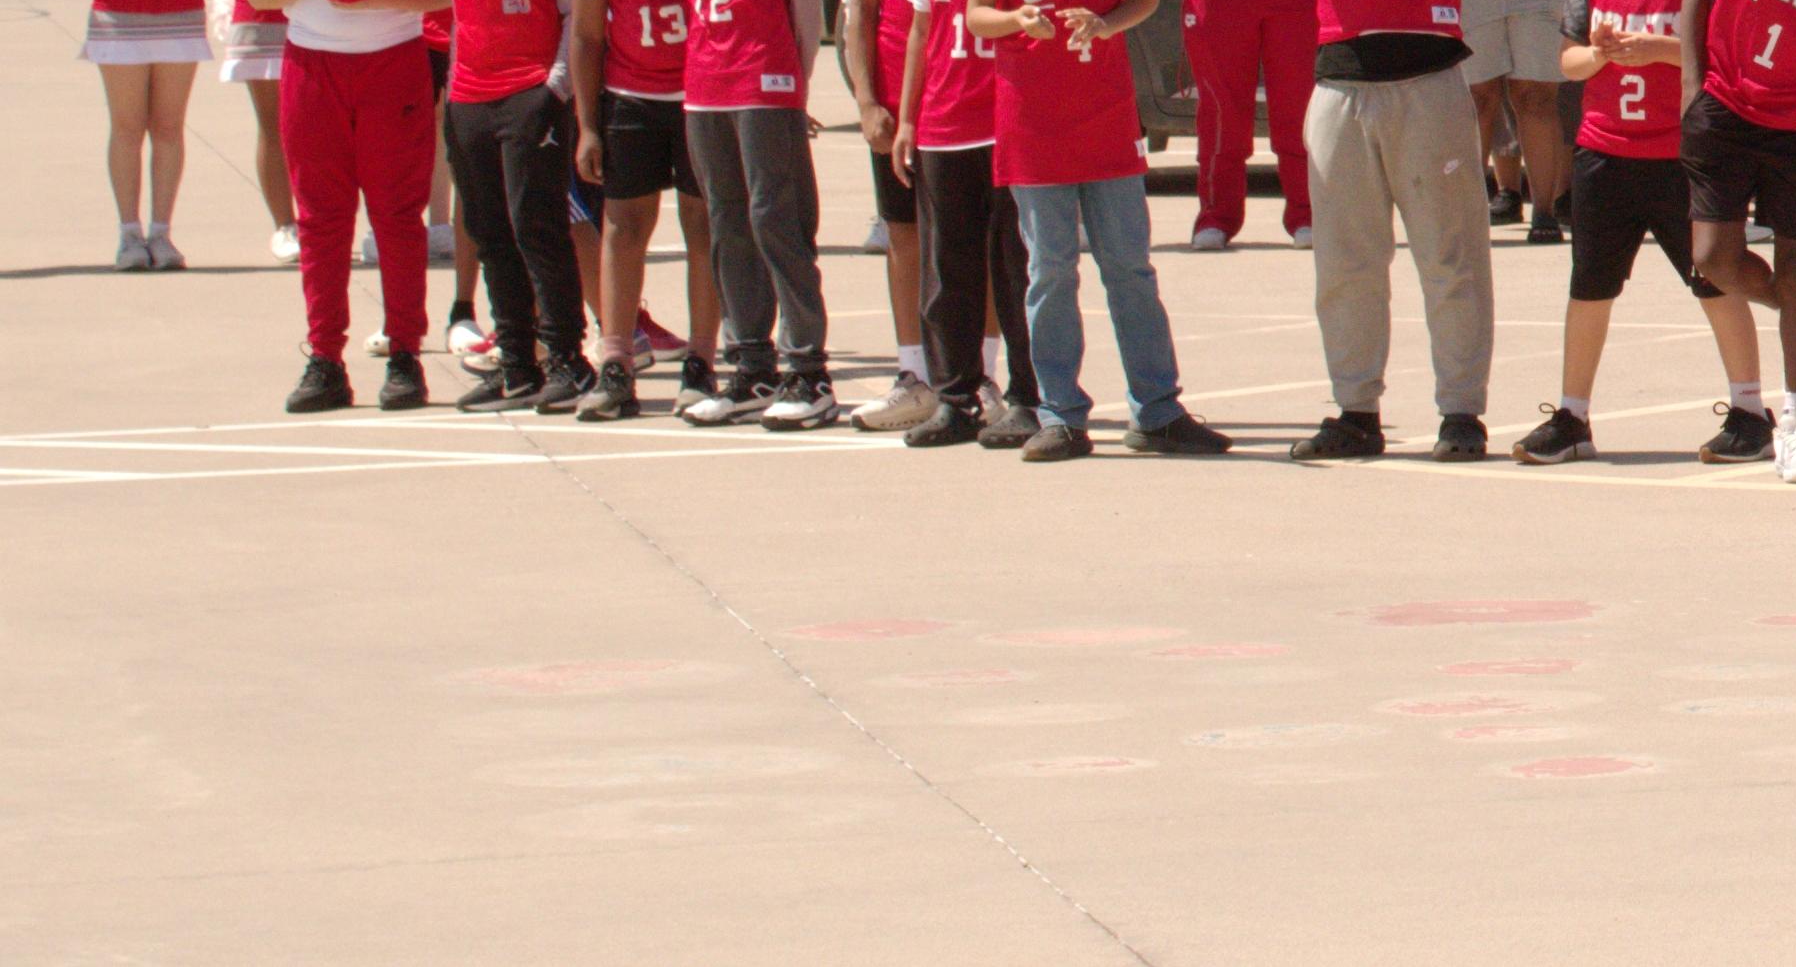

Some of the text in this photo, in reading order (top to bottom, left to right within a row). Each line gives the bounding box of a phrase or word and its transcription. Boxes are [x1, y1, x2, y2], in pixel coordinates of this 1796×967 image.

[638, 3, 688, 48] 13
[1753, 23, 1784, 70] 1
[1618, 73, 1646, 121] 2
